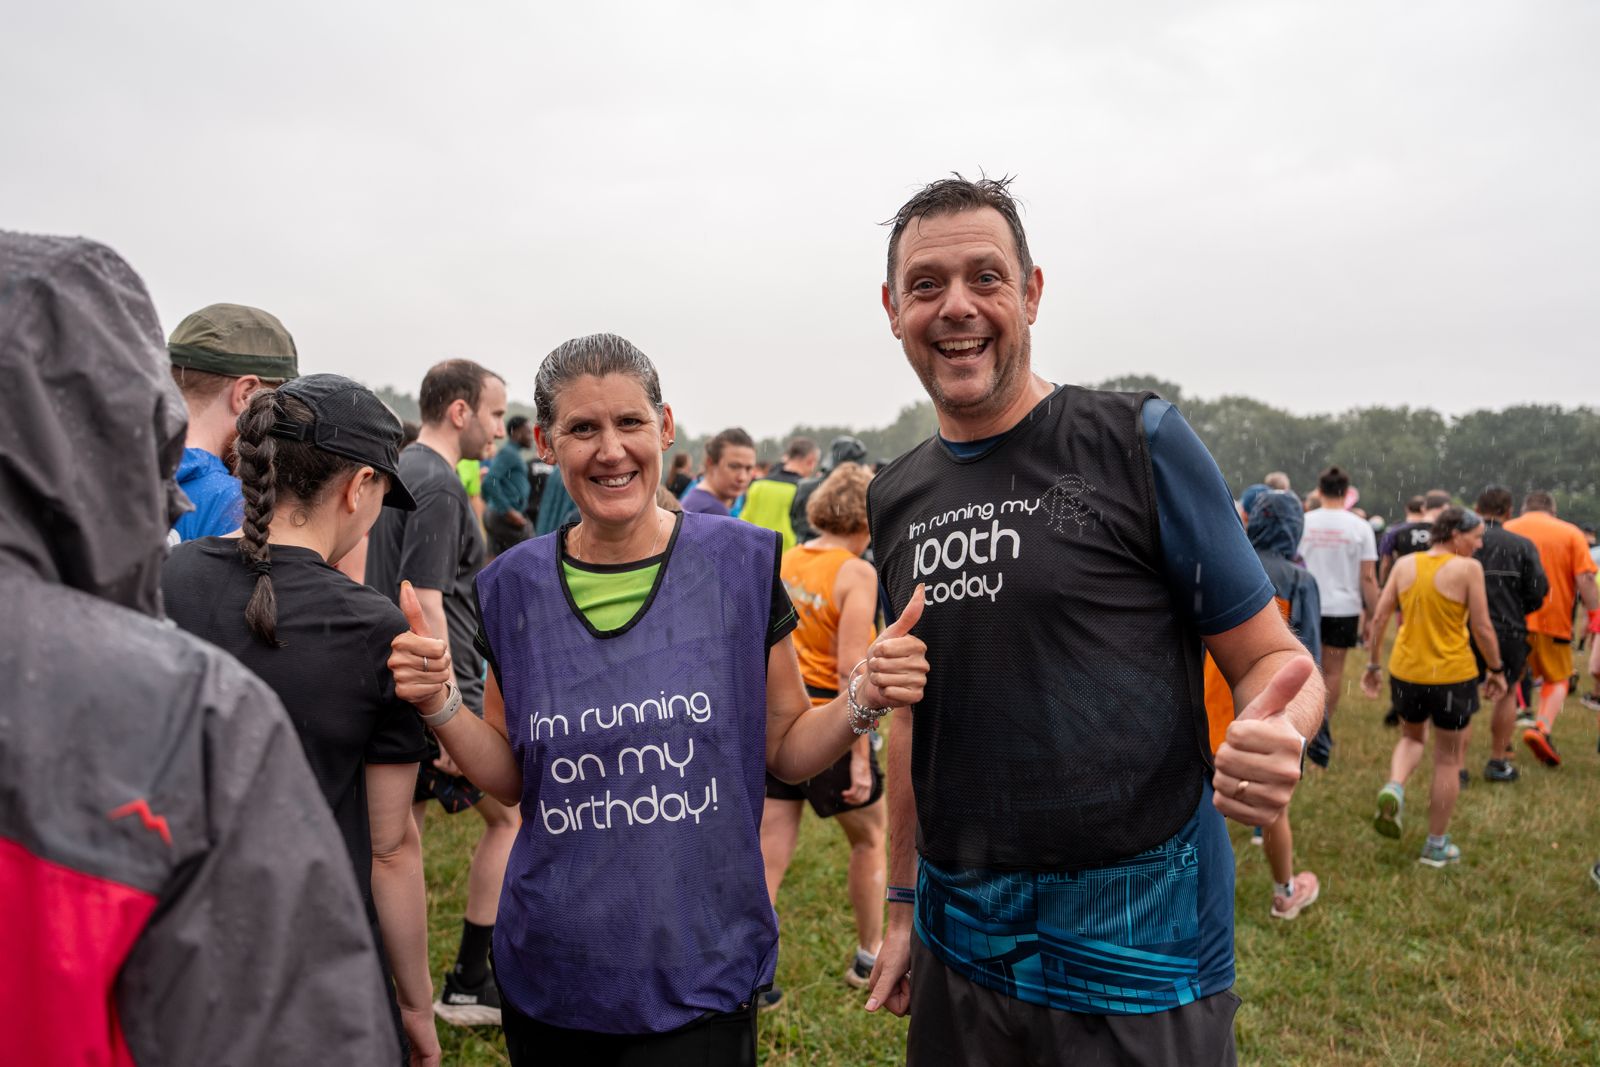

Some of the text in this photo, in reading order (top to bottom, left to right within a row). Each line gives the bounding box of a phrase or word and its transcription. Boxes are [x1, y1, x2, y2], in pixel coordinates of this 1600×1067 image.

[929, 503, 995, 530] running
[1000, 498, 1041, 516] my
[912, 519, 1021, 580] 100th
[530, 691, 712, 742] I'm running
[551, 738, 694, 784] on my
[540, 777, 719, 835] birthday!
